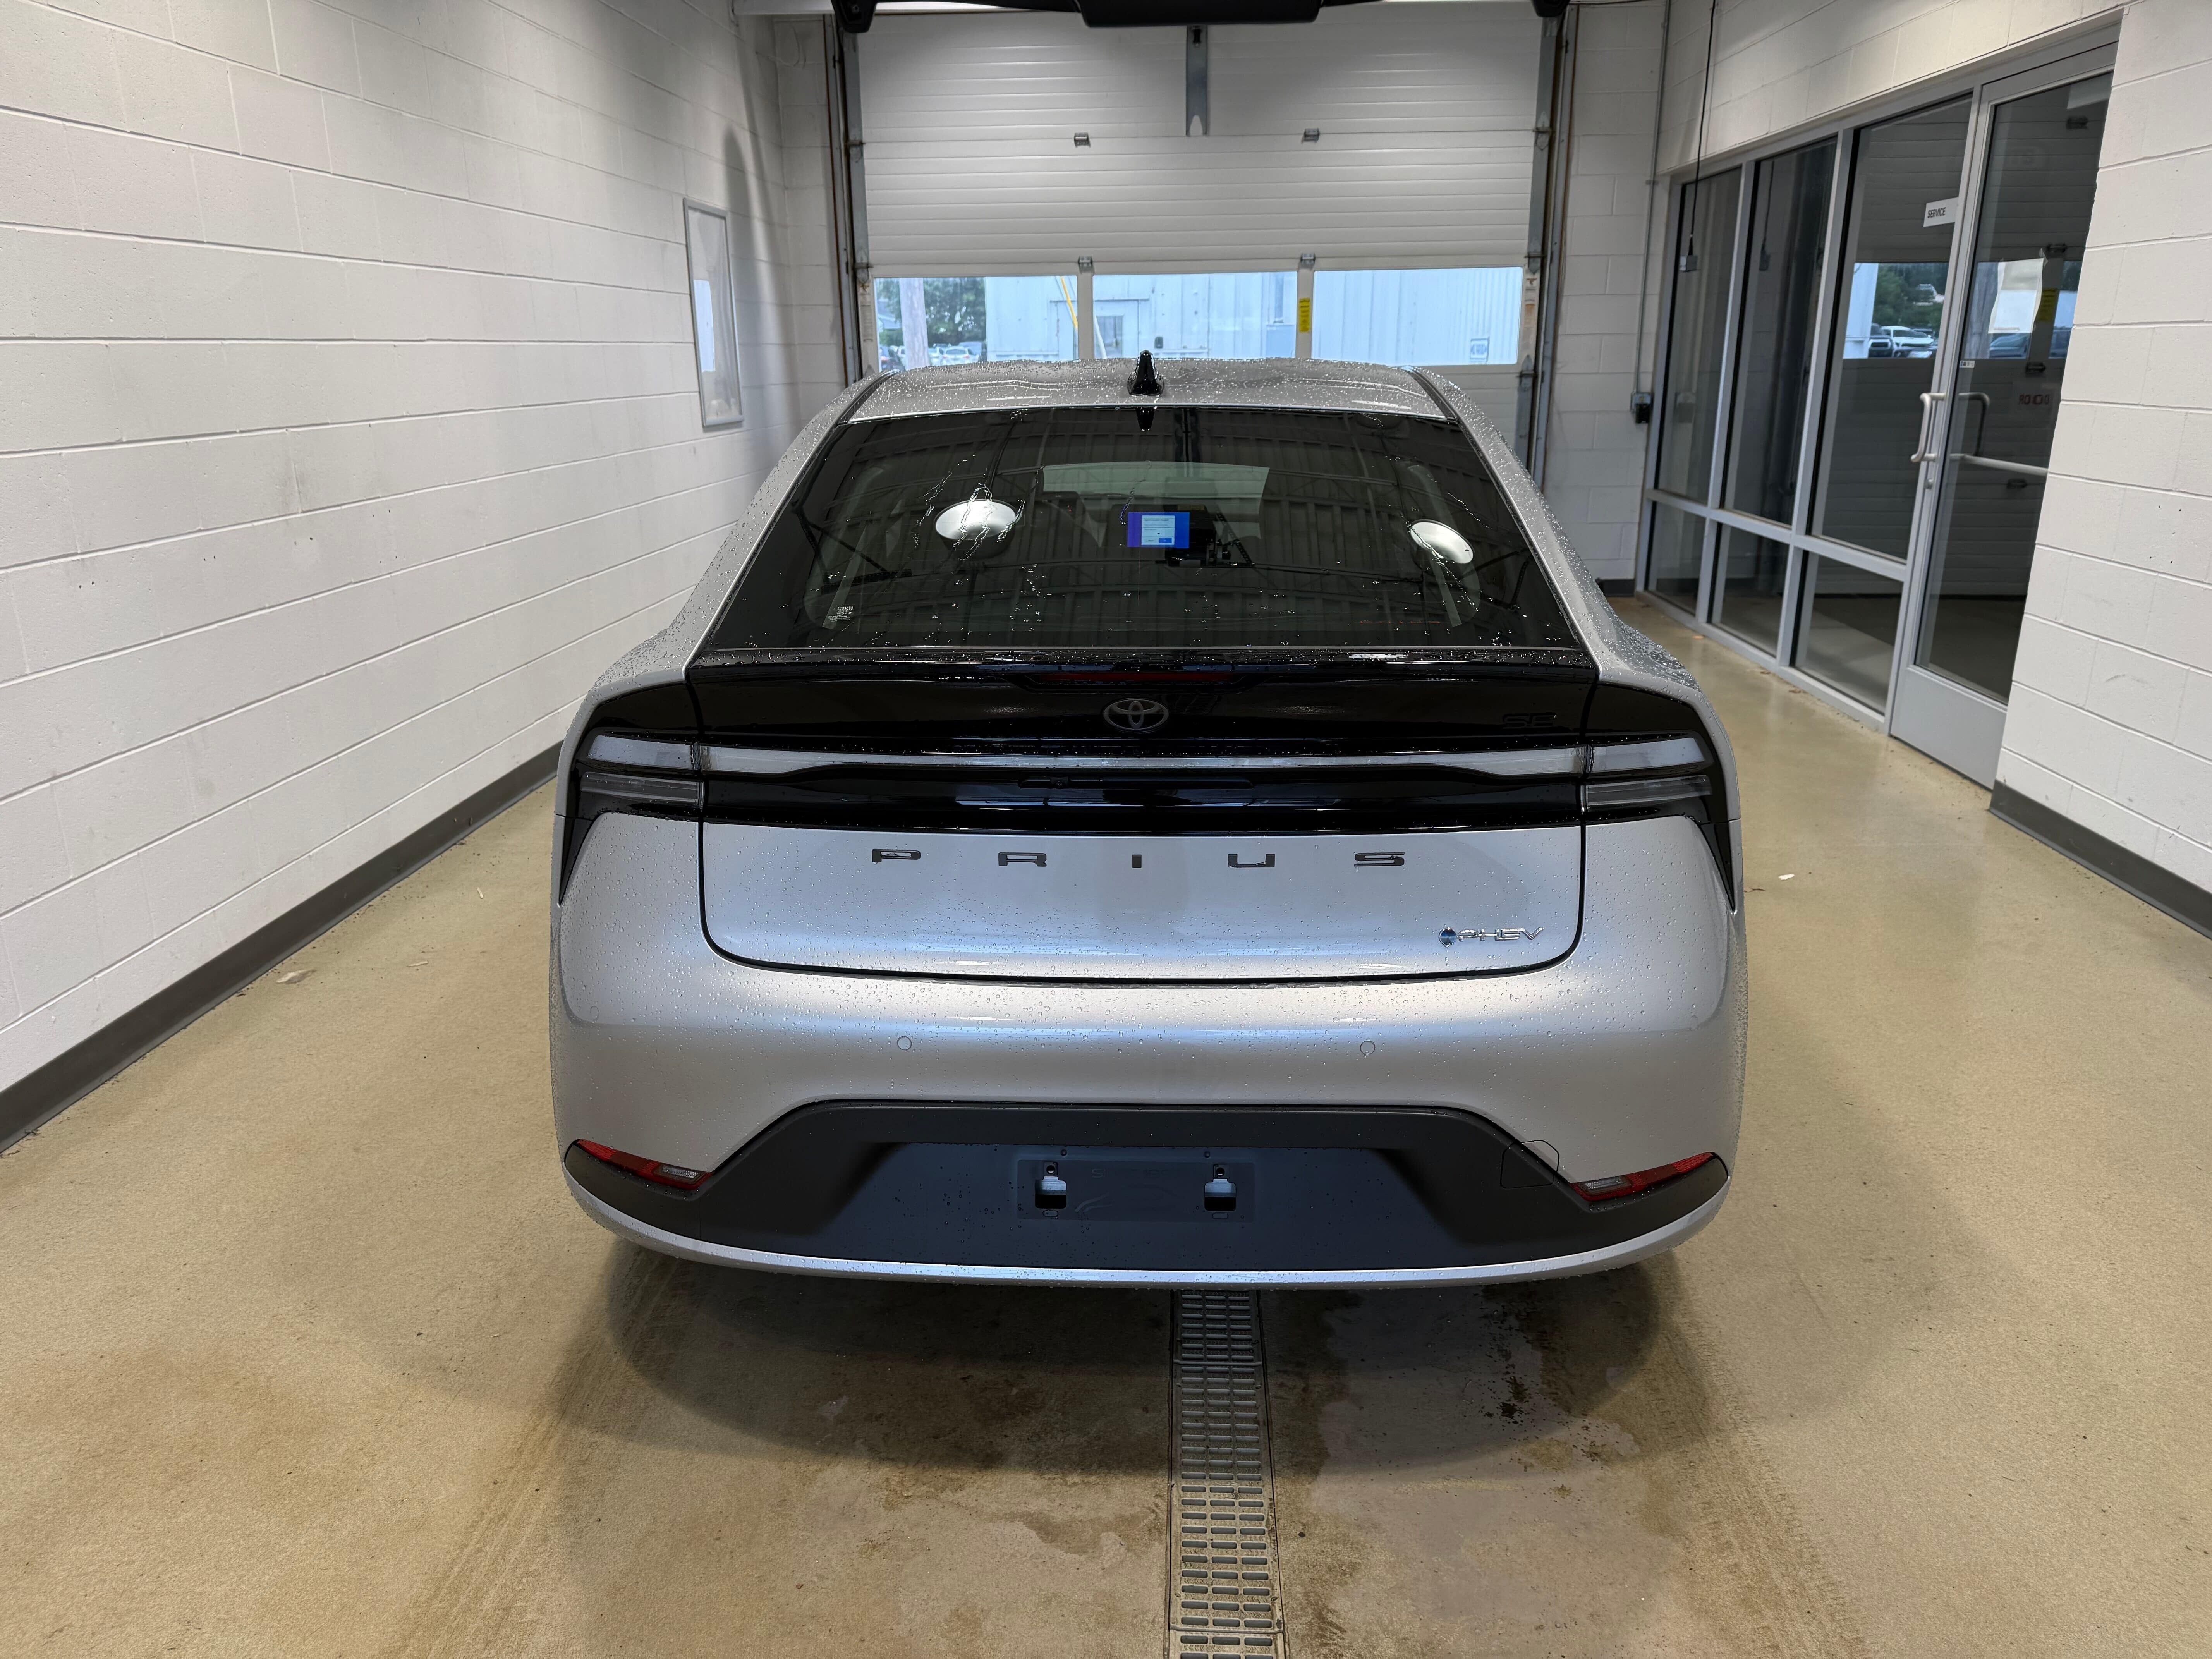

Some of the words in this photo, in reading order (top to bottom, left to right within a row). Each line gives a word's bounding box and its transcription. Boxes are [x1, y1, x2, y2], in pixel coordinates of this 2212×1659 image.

[1927, 207, 1946, 218] SERVICE
[1502, 712, 1556, 728] SE
[871, 848, 1405, 868] PRIUS
[1458, 927, 1545, 941] PHEV
